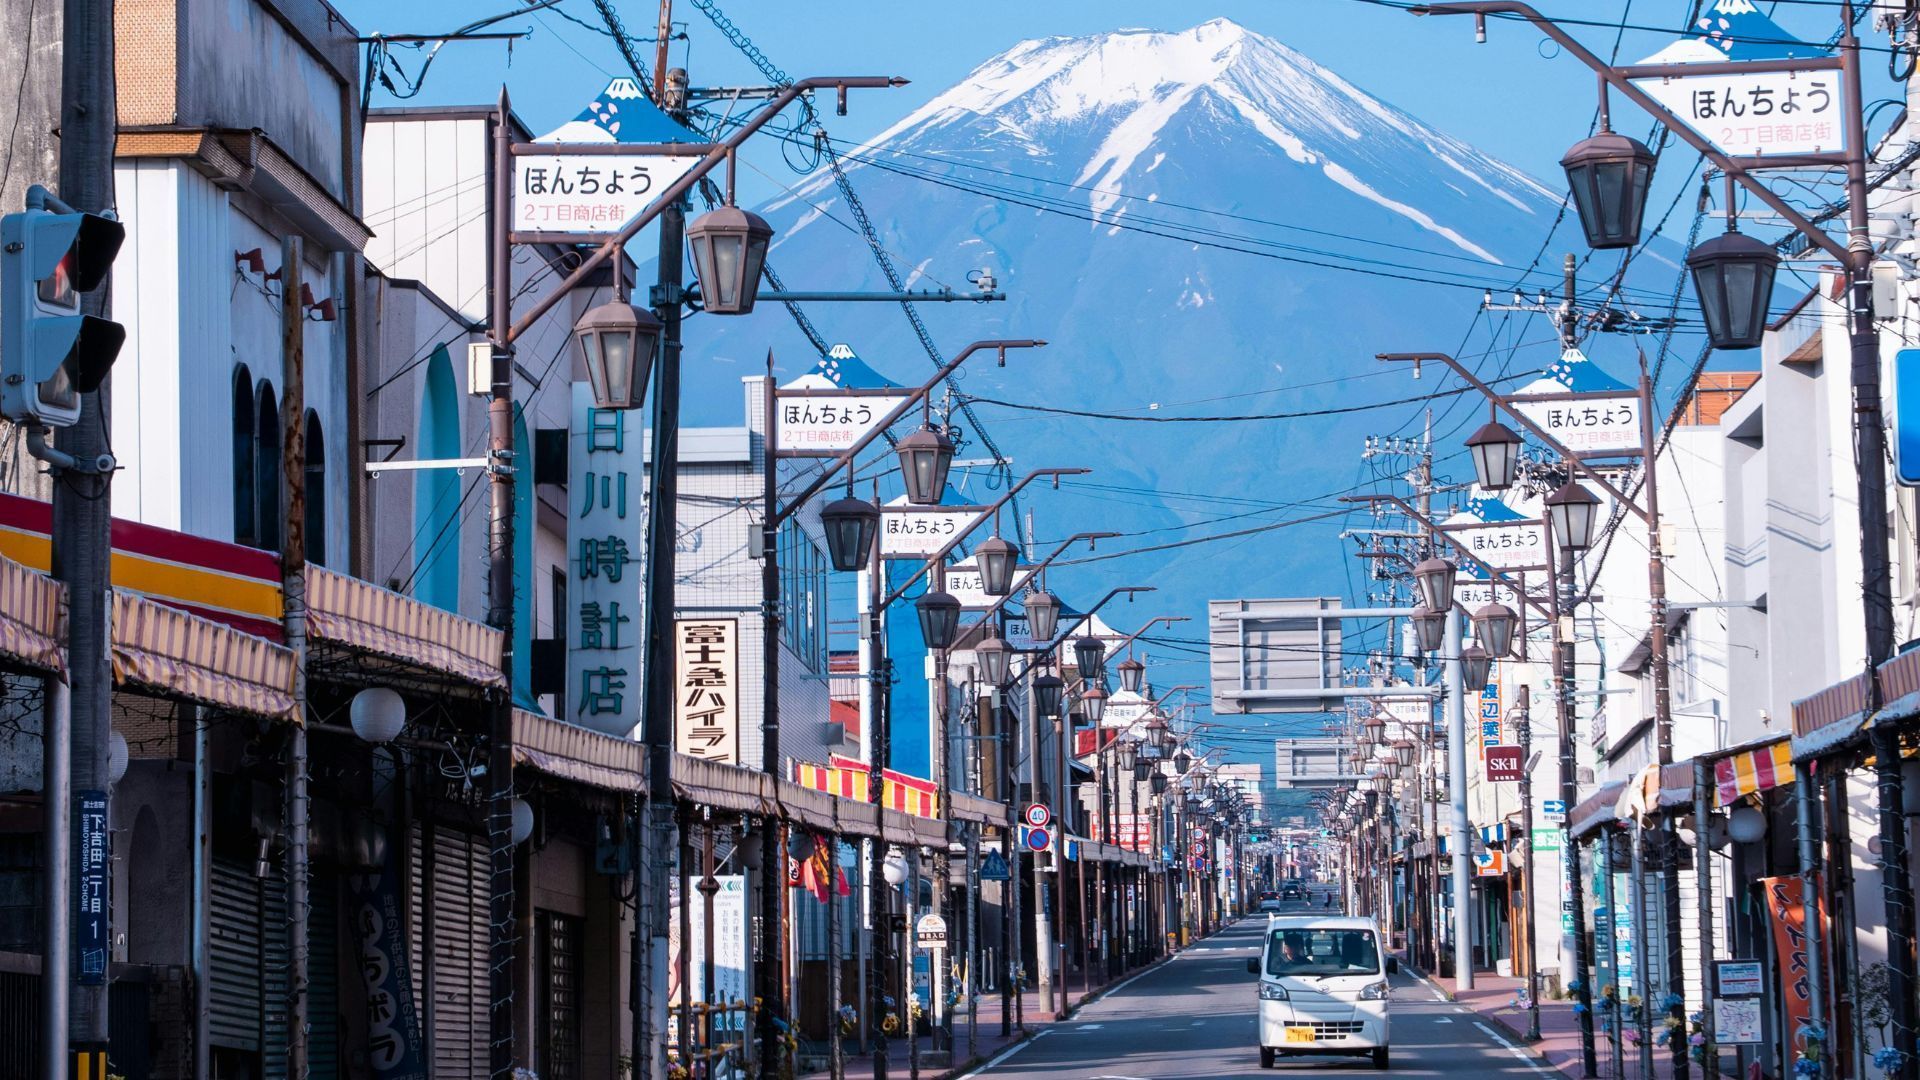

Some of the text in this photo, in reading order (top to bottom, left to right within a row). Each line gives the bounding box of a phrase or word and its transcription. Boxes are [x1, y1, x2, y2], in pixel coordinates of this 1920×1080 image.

[1692, 81, 1831, 119] ほんちょう
[1722, 121, 1832, 146] 2丁目商店街
[524, 166, 652, 195] ほんちょう
[524, 204, 625, 221] 2丁目商店街
[784, 404, 872, 425] ほんちょう
[1547, 405, 1633, 429] ほんちょう
[784, 430, 853, 443] 2丁目商店街
[1566, 430, 1634, 445] 2丁目商店街
[887, 518, 955, 535] ほんちょう
[1473, 530, 1538, 550] ほんちょう
[580, 407, 630, 718] 日川時計店
[950, 576, 984, 590] ほんち
[1490, 757, 1518, 771] SK-II
[1031, 810, 1044, 821] 40
[82, 813, 90, 912] SHIMOYOSHIDA 2-CHOME
[90, 814, 103, 939] 下吉田二丁目 1
